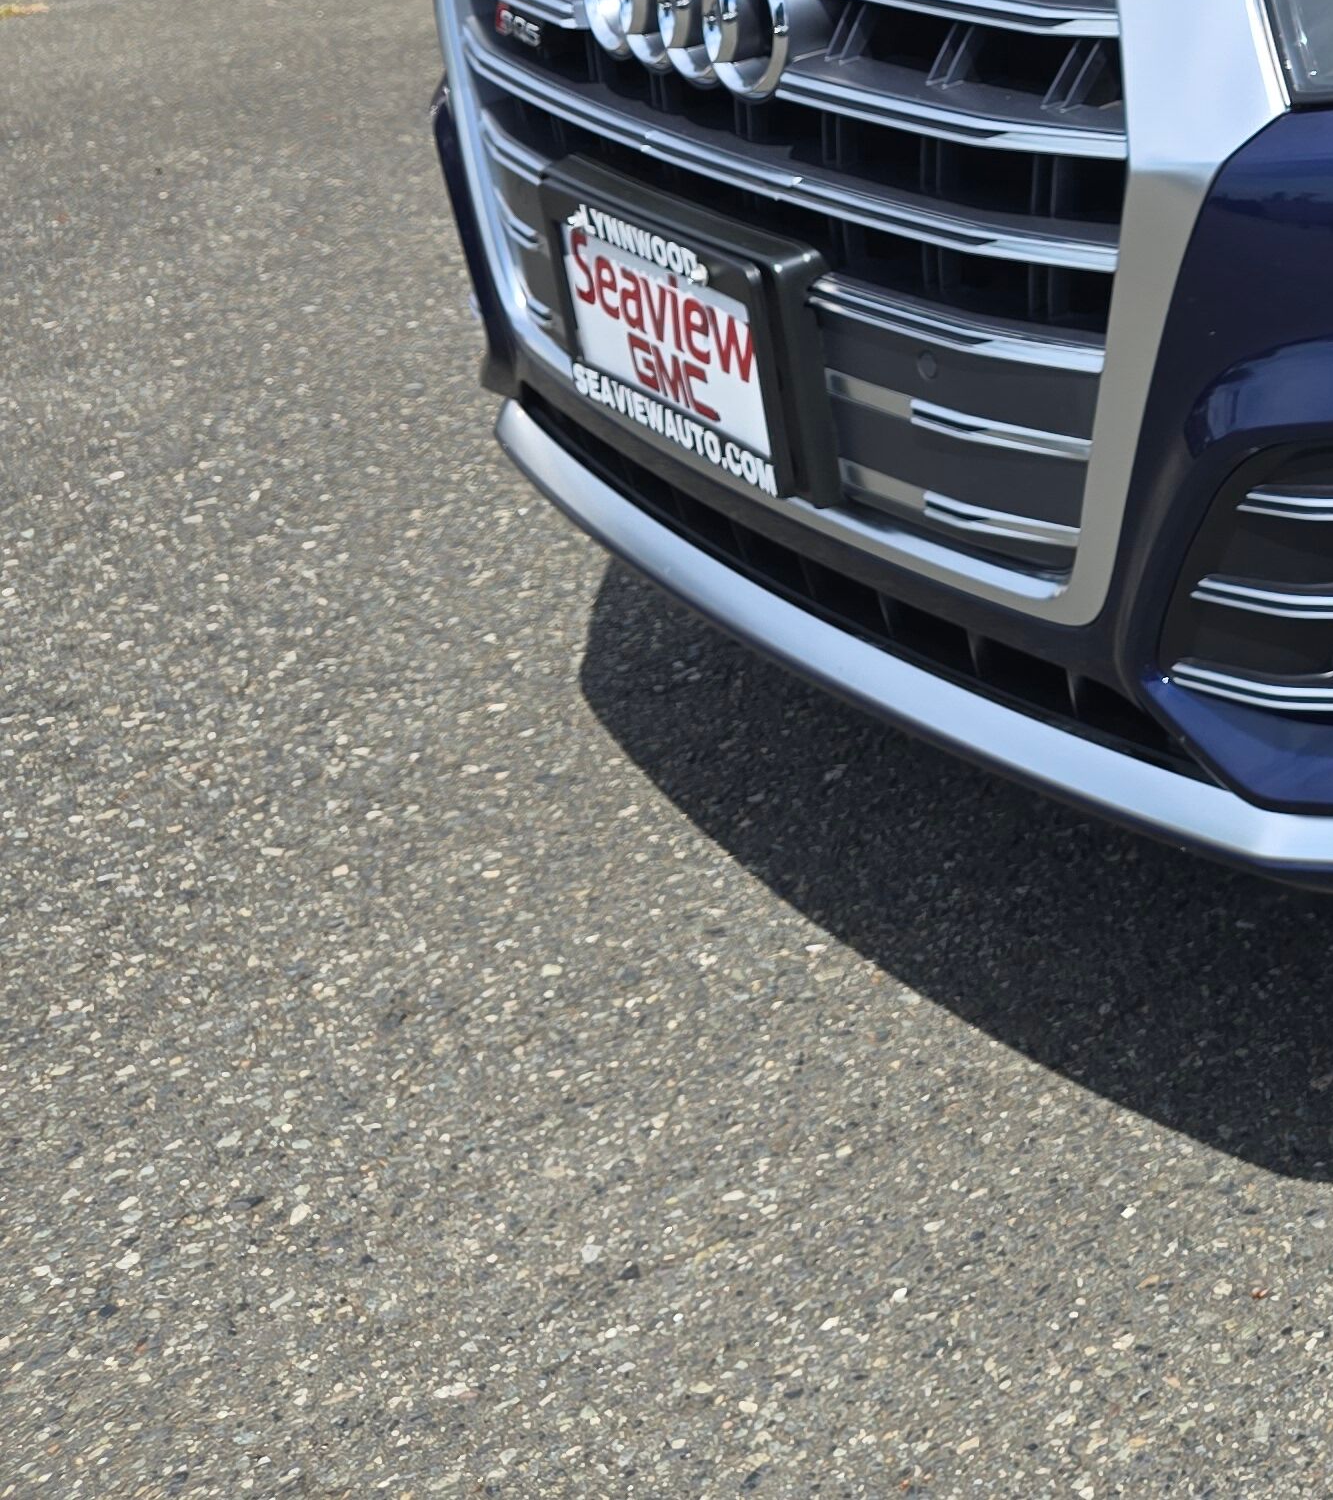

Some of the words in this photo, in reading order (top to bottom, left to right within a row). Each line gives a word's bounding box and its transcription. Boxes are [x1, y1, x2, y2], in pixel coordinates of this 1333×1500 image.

[570, 226, 756, 383] Seaview
[572, 363, 778, 497] SEAVIEWAUTO.COM
[627, 332, 721, 422] GMC
